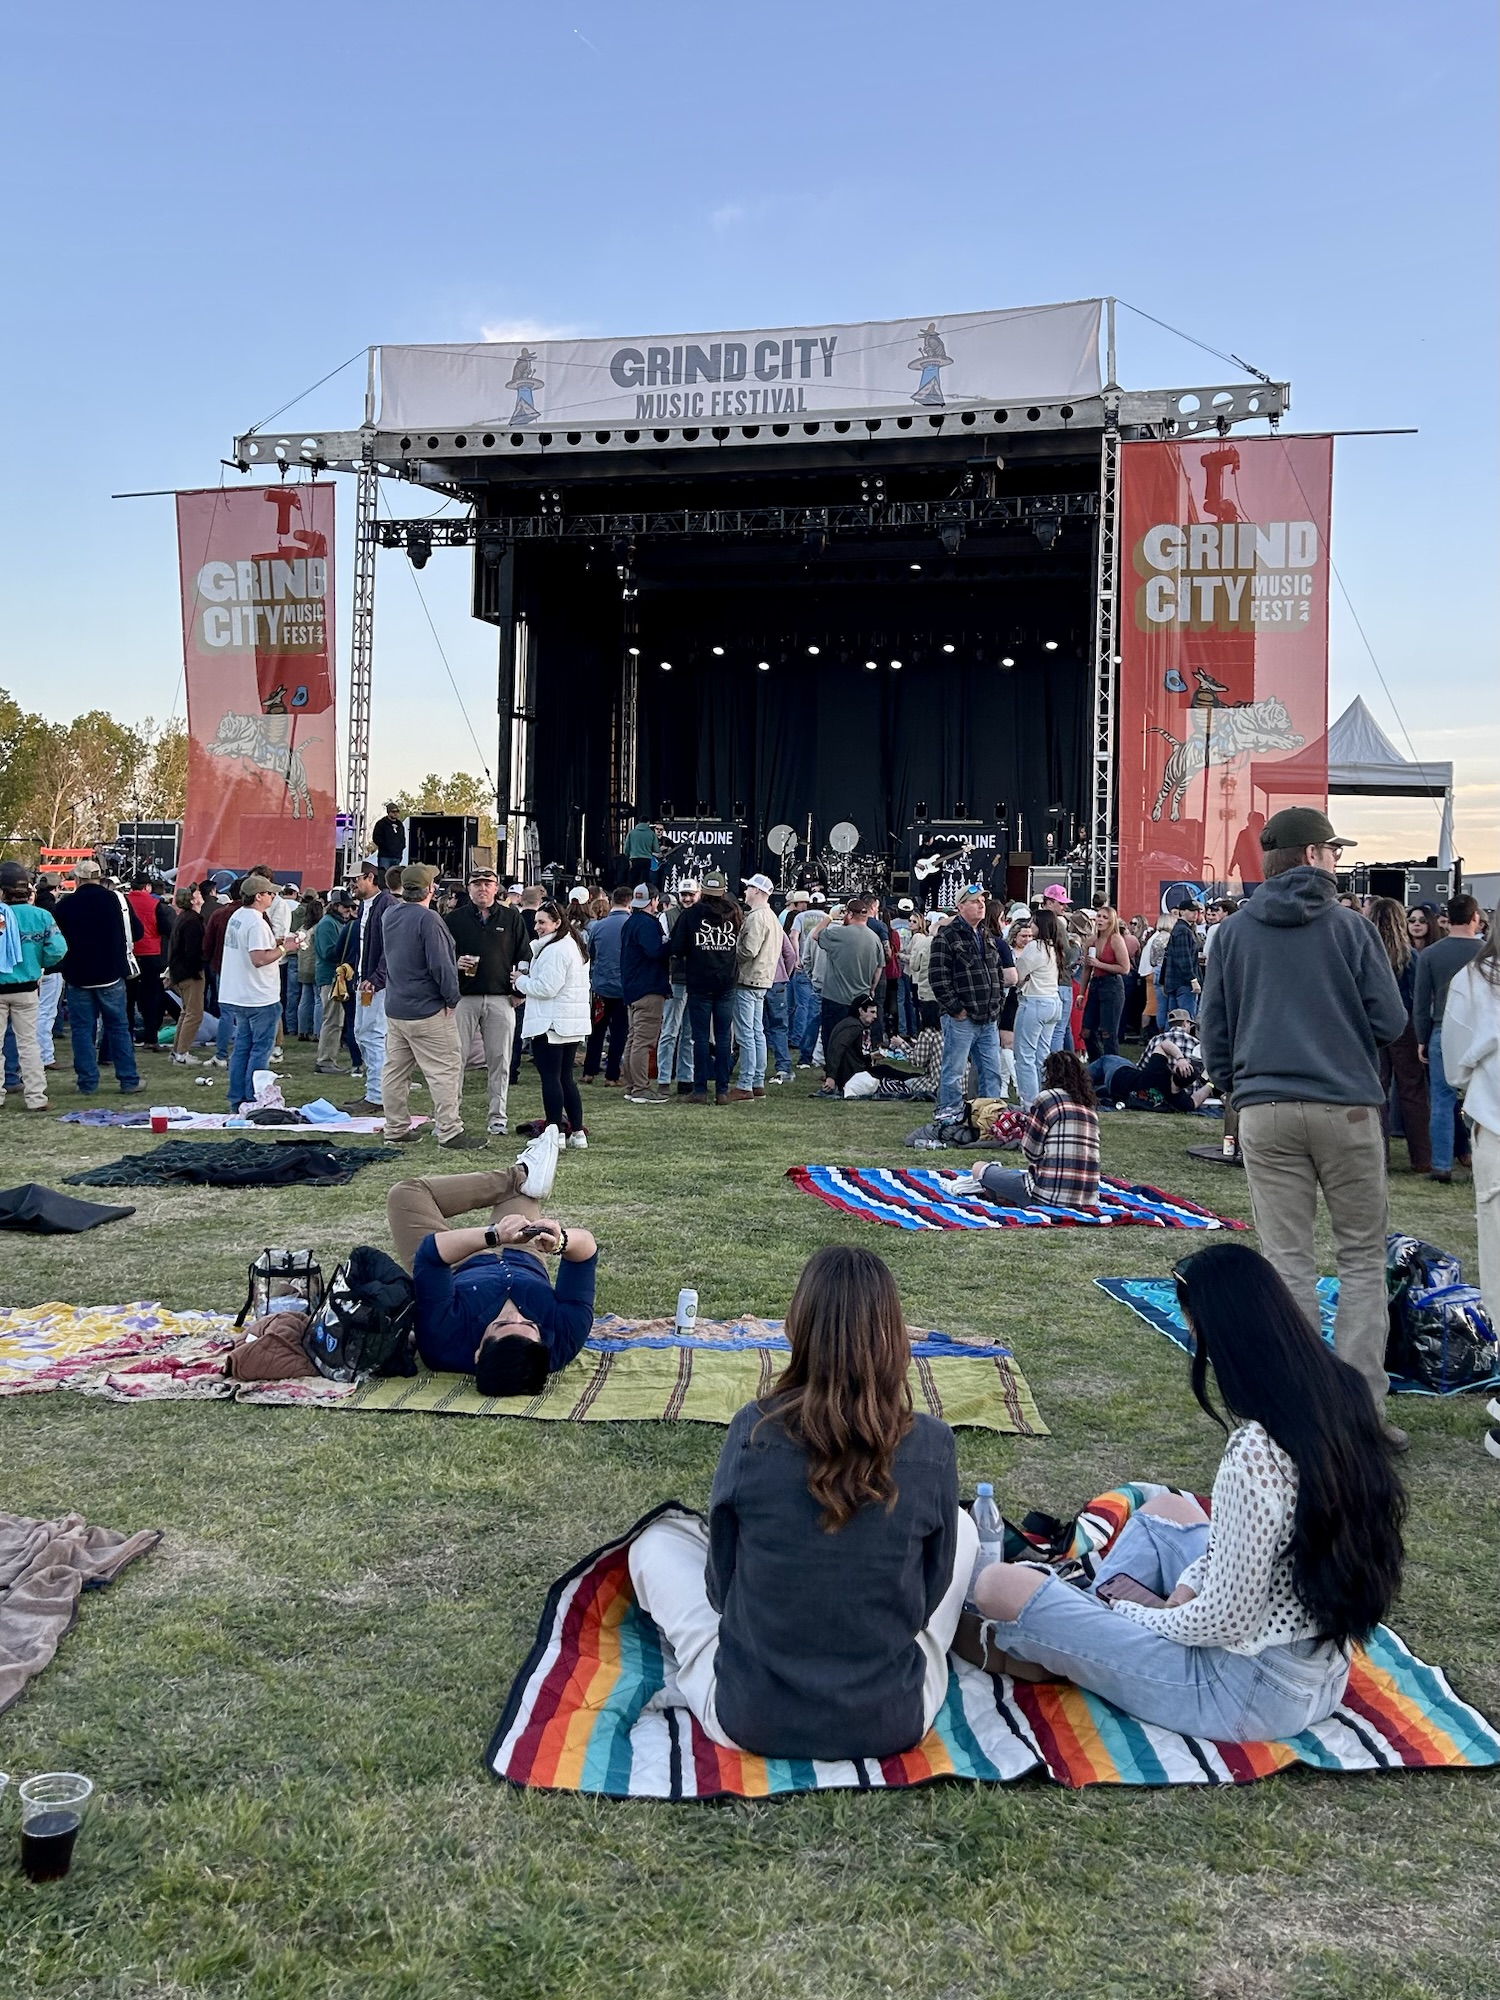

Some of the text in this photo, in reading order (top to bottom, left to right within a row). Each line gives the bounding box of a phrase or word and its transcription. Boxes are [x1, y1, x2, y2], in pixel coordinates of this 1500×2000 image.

[610, 336, 838, 388] GRIND CITY
[636, 387, 807, 419] MUSIC FESTIVAL
[1143, 521, 1317, 571] GRIND
[198, 558, 327, 602] GRIND
[1251, 574, 1312, 597] MUSIC
[1145, 575, 1247, 623] CITY
[1250, 600, 1294, 621] FEST
[203, 605, 282, 647] CITY
[283, 603, 323, 623] MUSIC
[283, 626, 315, 645] FEST
[662, 830, 733, 845] MUSCADINE
[695, 932, 736, 946] DADS
